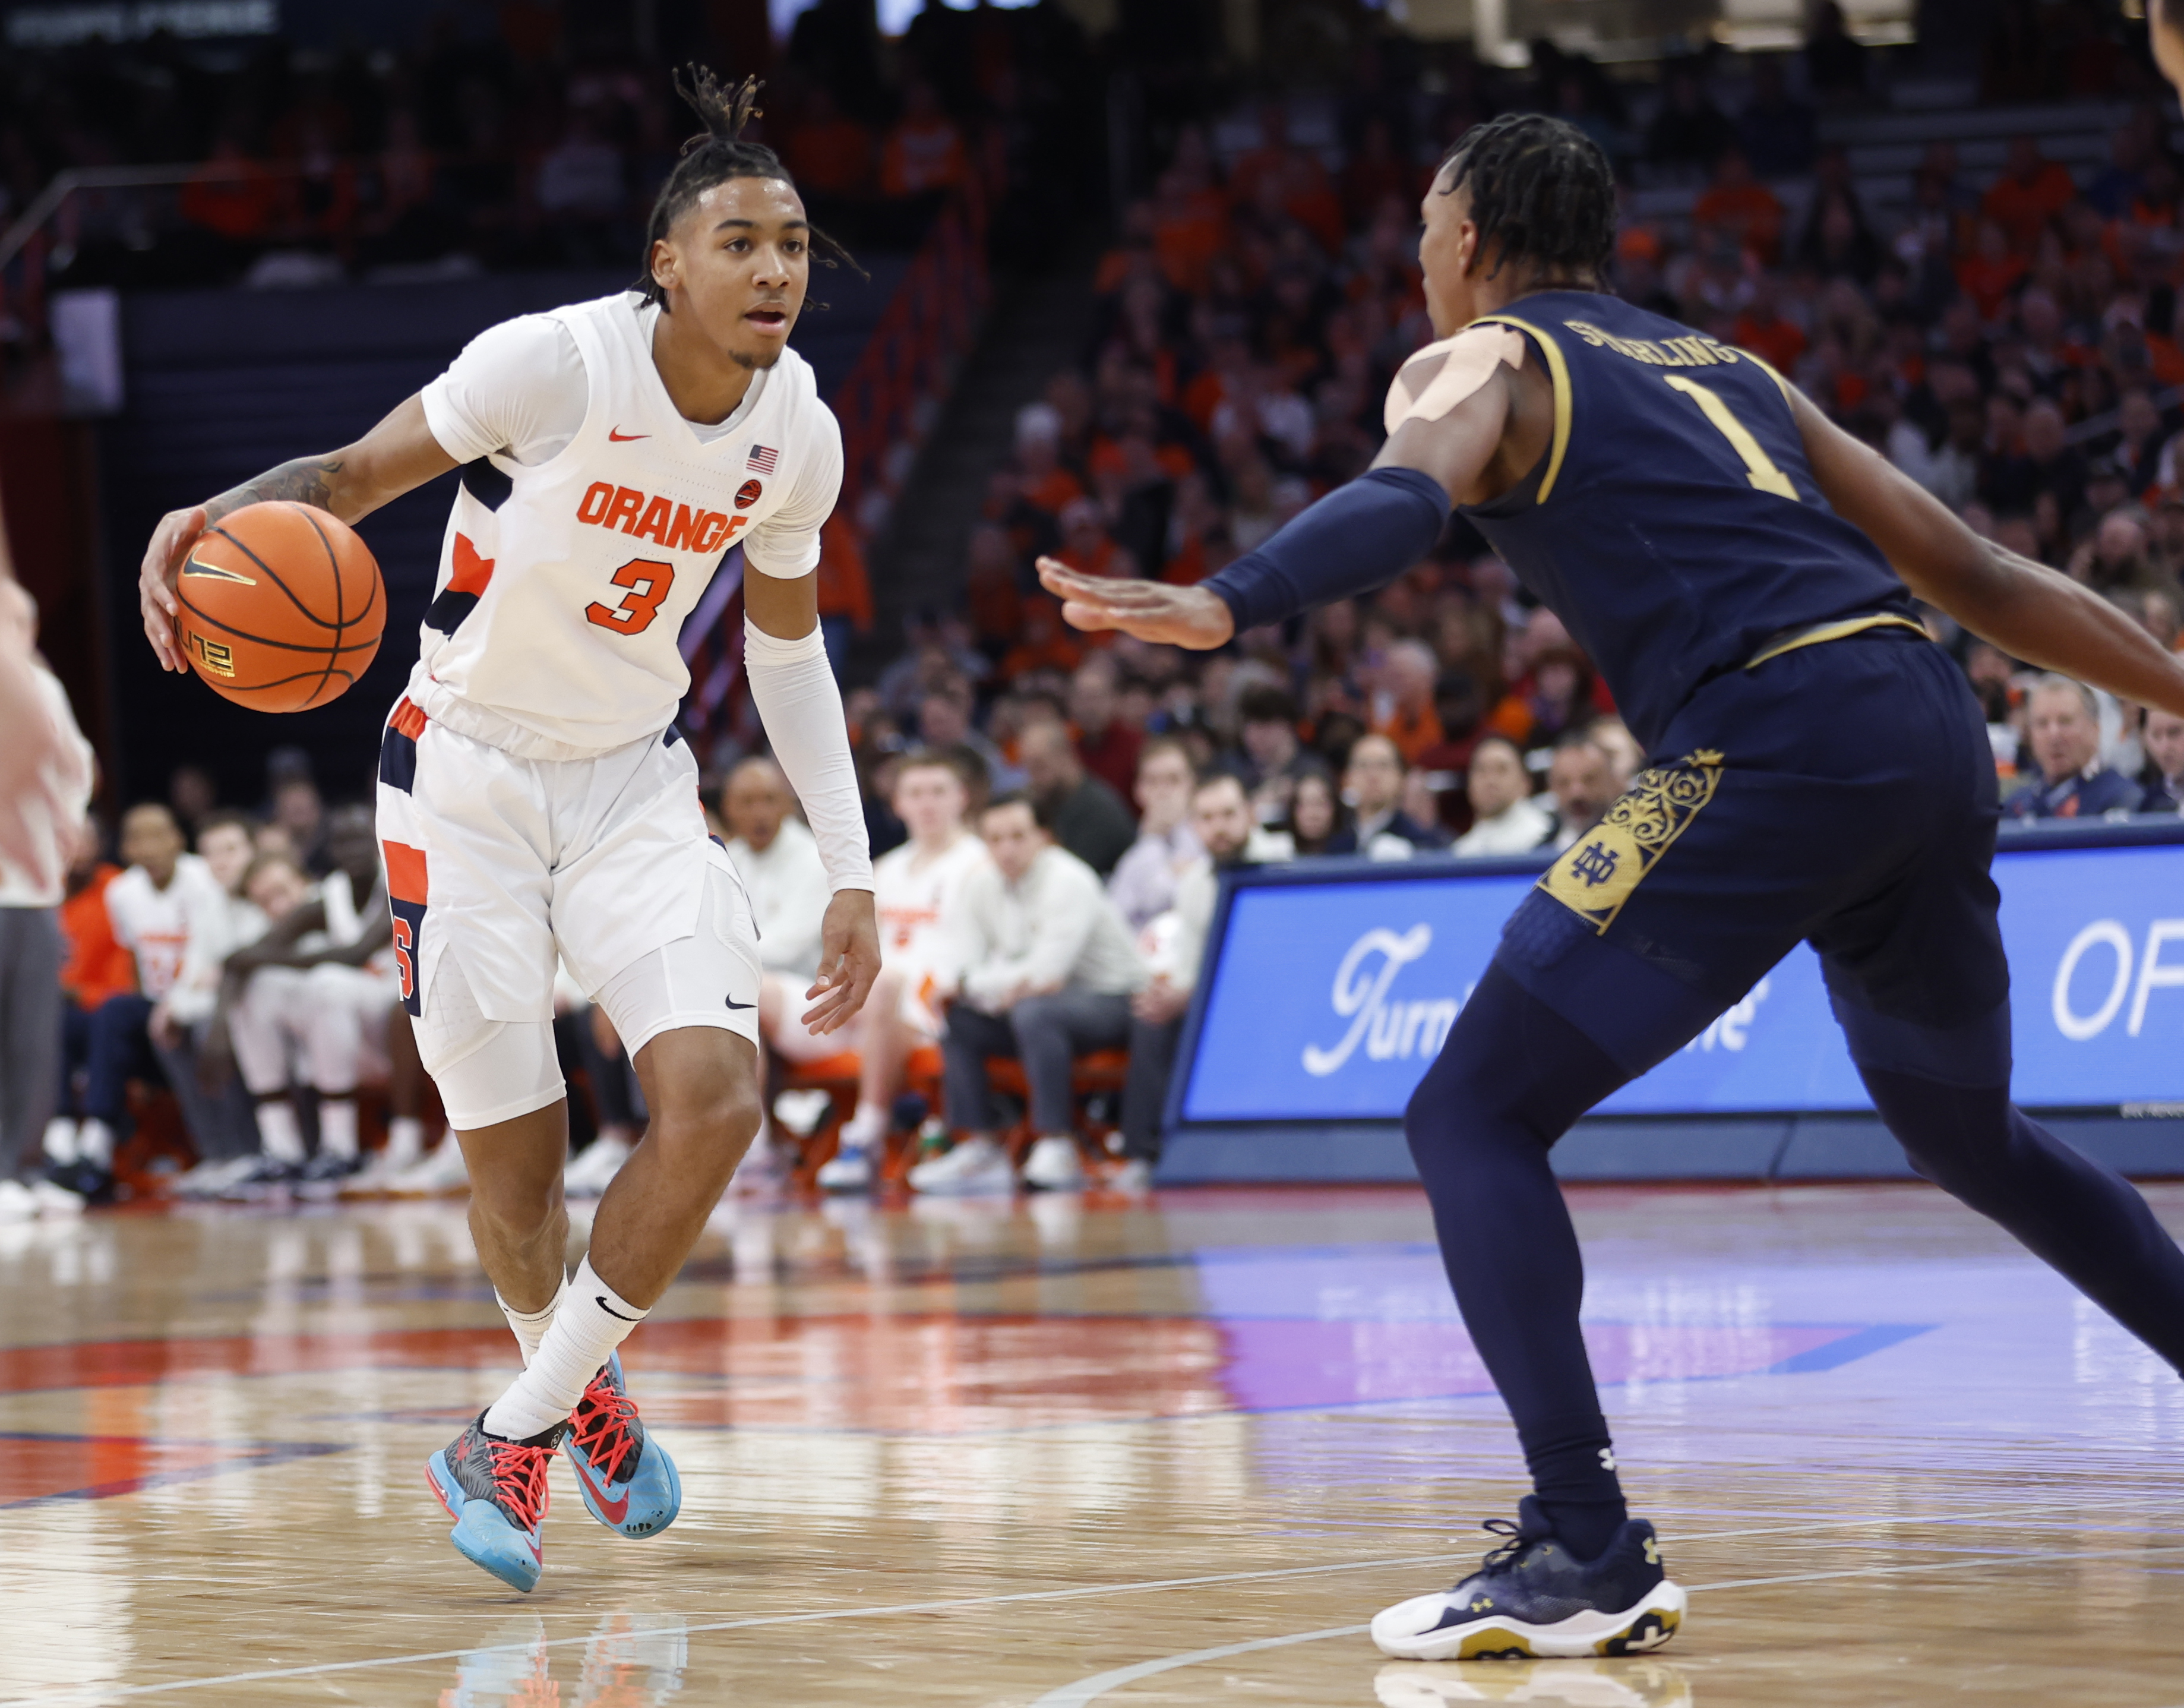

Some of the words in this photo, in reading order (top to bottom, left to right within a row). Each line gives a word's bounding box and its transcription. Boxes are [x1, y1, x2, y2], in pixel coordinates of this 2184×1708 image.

[1663, 374, 1801, 502] 1
[576, 481, 749, 554] ORANGE
[584, 558, 675, 636] 3
[393, 915, 413, 999] S
